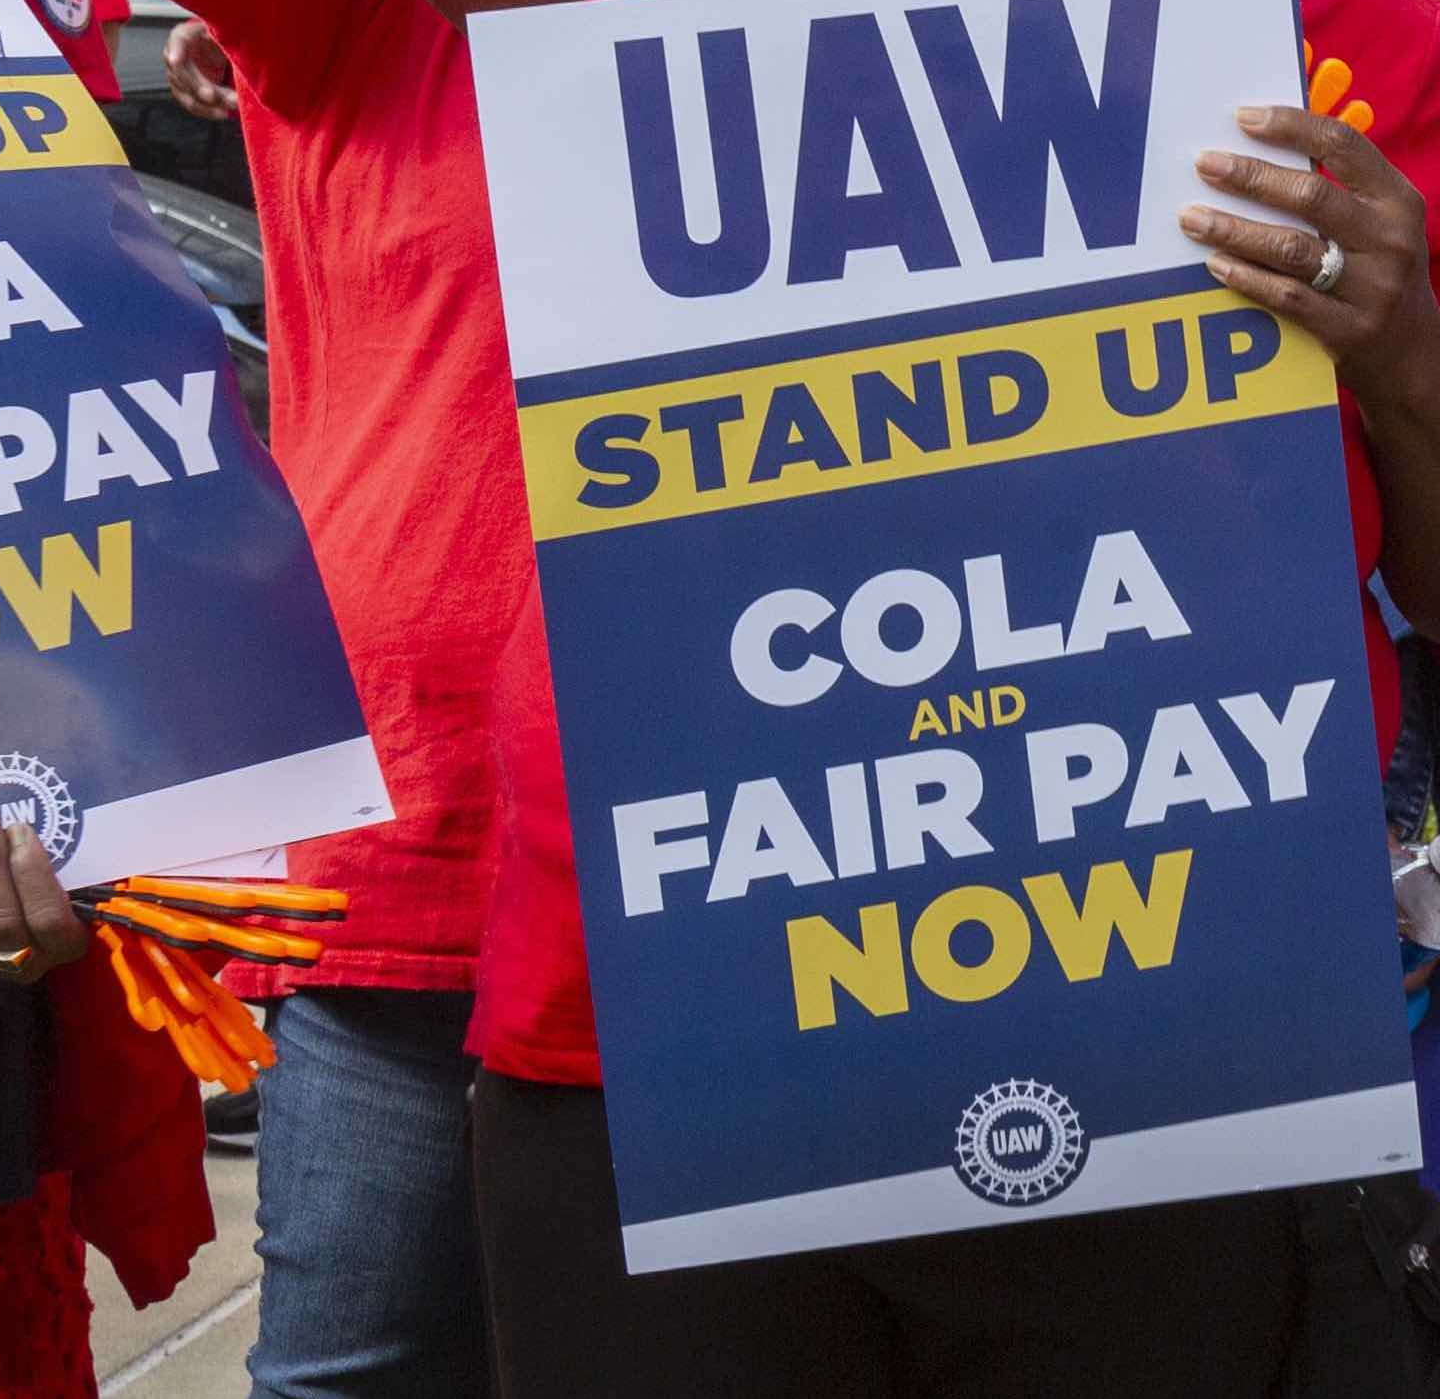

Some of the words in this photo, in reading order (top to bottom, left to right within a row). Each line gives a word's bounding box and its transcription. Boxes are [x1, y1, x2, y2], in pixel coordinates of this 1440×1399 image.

[576, 351, 1048, 507] STAND
[1097, 309, 1279, 415] UP
[731, 531, 1191, 705] COLA
[613, 750, 993, 916] FAIR
[1026, 680, 1334, 842] PAY
[910, 685, 1026, 740] AND
[788, 851, 1191, 1028] NOW
[991, 1123, 1044, 1157] UAW
